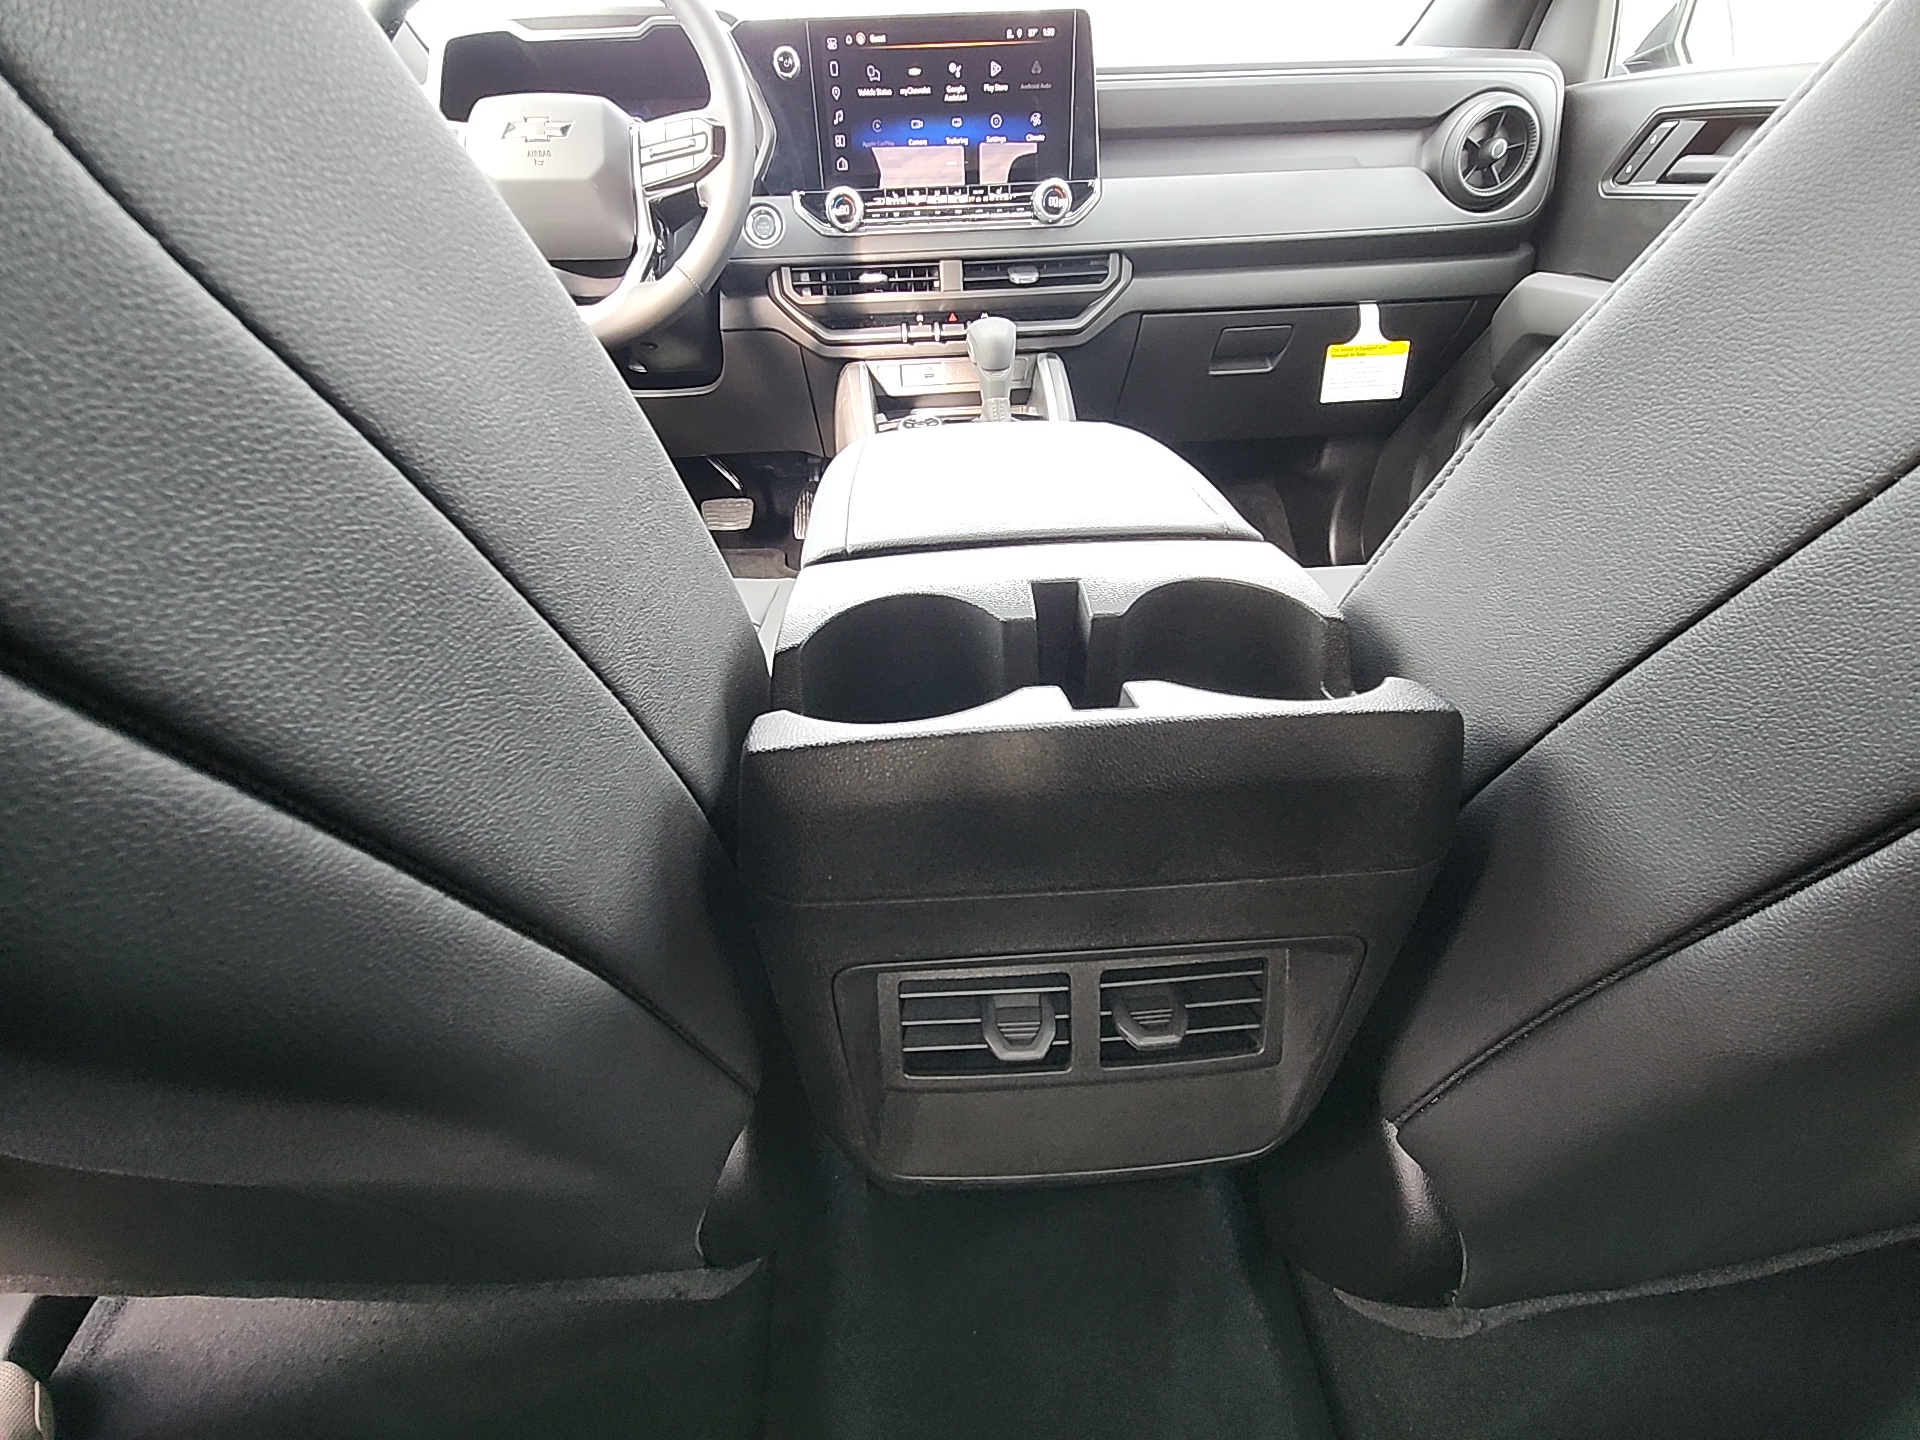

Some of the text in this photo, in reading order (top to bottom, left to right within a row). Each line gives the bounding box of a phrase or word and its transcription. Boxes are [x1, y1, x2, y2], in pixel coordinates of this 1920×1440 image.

[857, 87, 893, 97] Vehicle Status
[945, 84, 966, 94] Google
[983, 83, 1009, 94] Play Store
